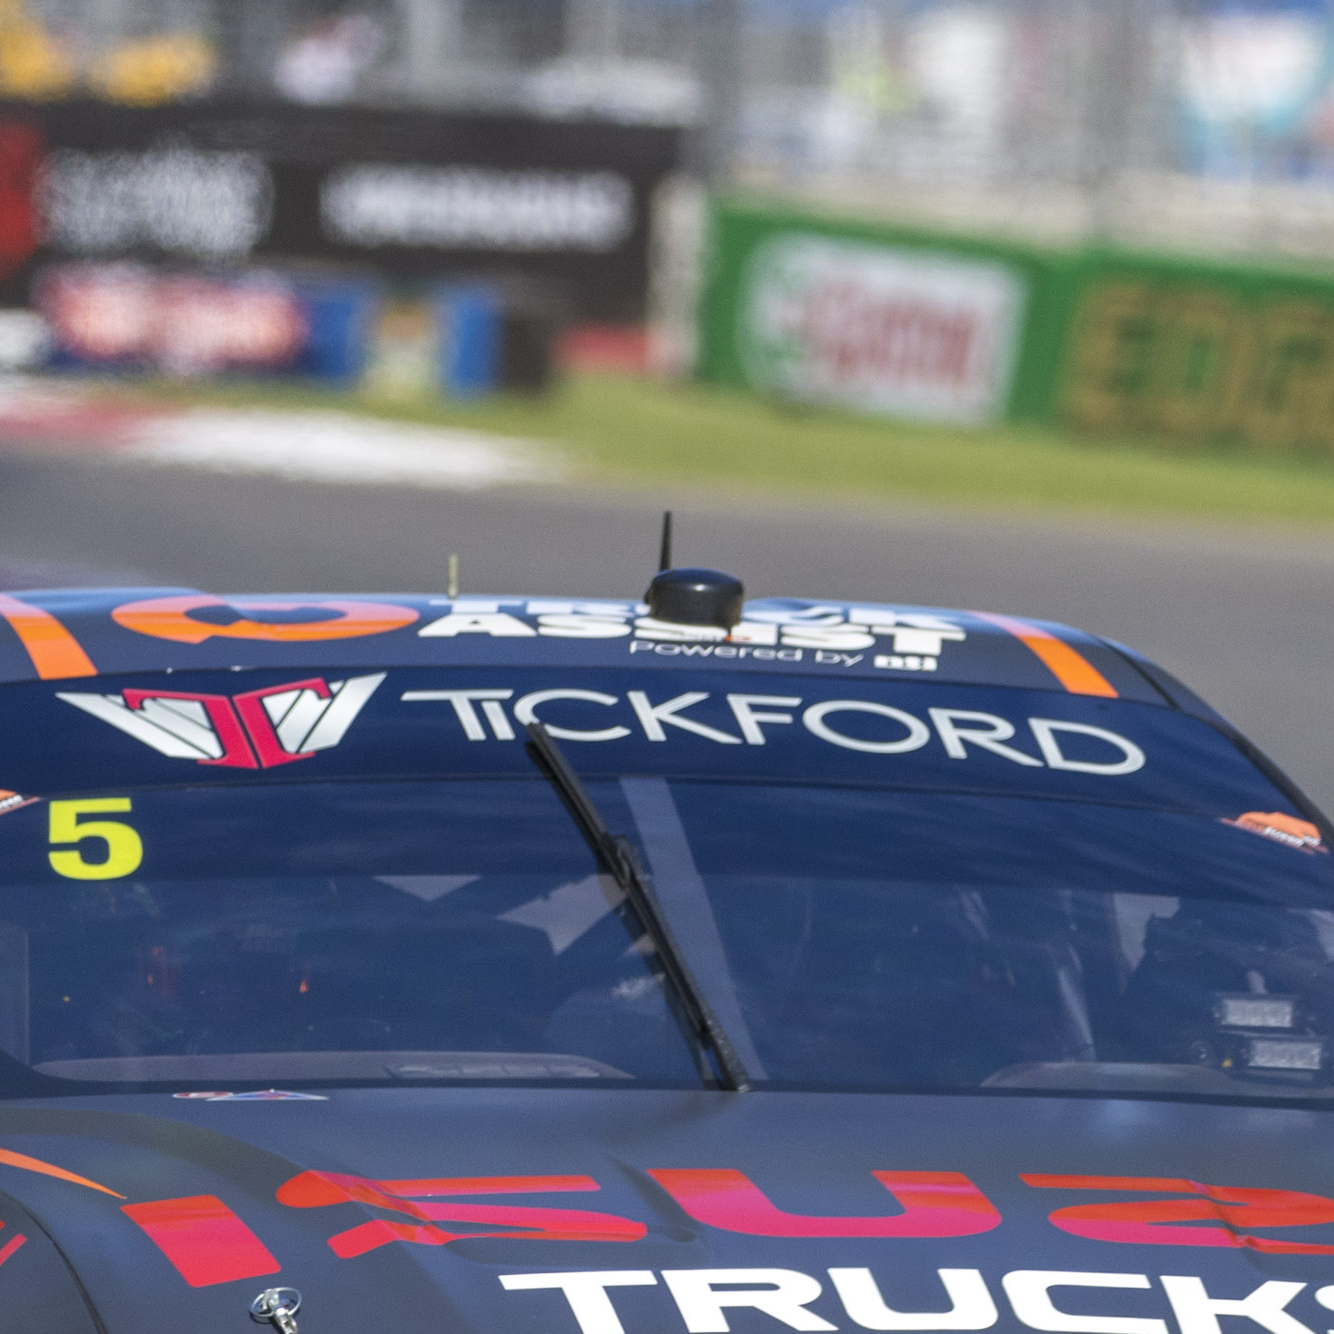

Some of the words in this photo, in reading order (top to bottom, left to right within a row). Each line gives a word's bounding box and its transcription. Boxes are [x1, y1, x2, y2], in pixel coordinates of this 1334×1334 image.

[418, 612, 966, 656] ASSIST
[630, 640, 803, 663] Powered
[814, 649, 865, 667] by
[48, 797, 144, 880] 5
